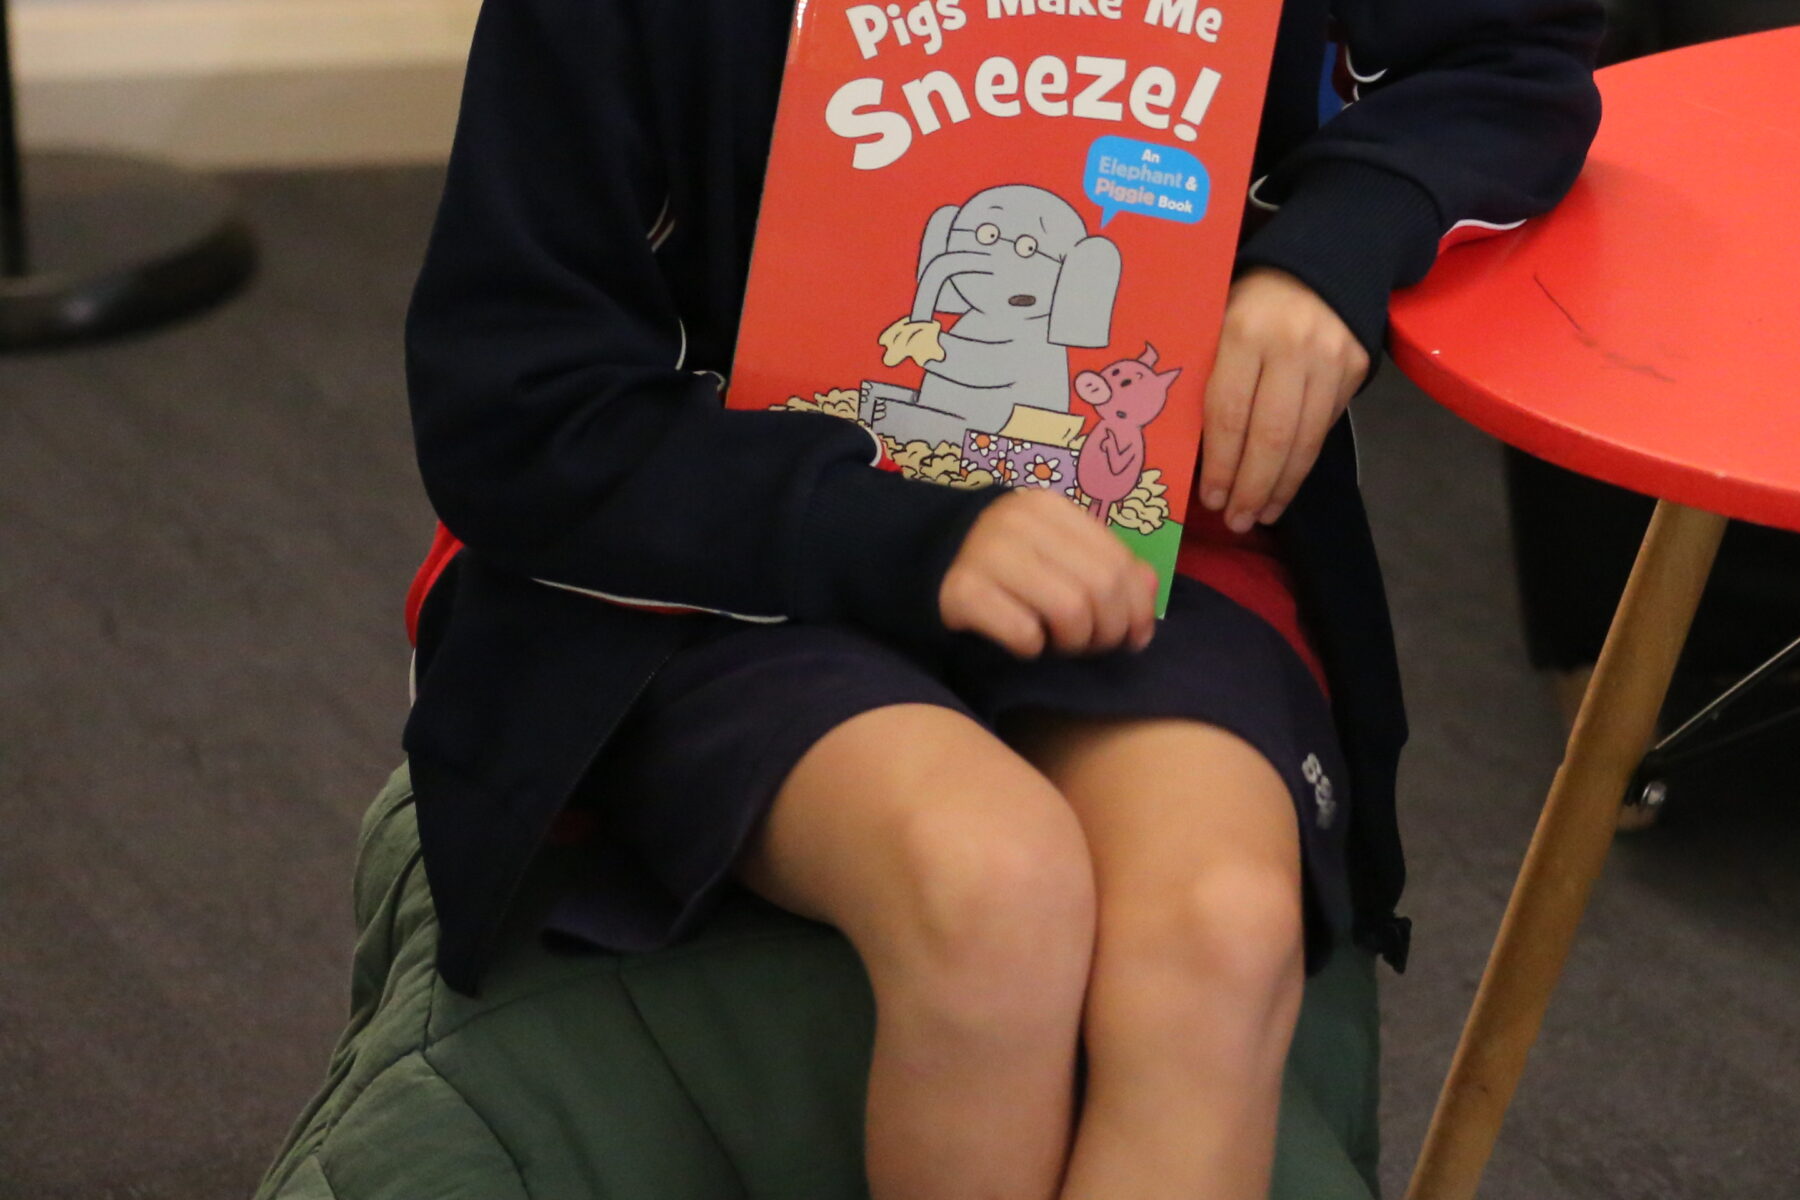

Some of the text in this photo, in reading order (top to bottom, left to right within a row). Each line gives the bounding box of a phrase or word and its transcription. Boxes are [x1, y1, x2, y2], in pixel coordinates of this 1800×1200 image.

[824, 54, 1223, 170] Sneeze!
[1099, 155, 1199, 192] Elephant &
[1141, 149, 1160, 164] An
[1095, 177, 1194, 214] Piggie Book
